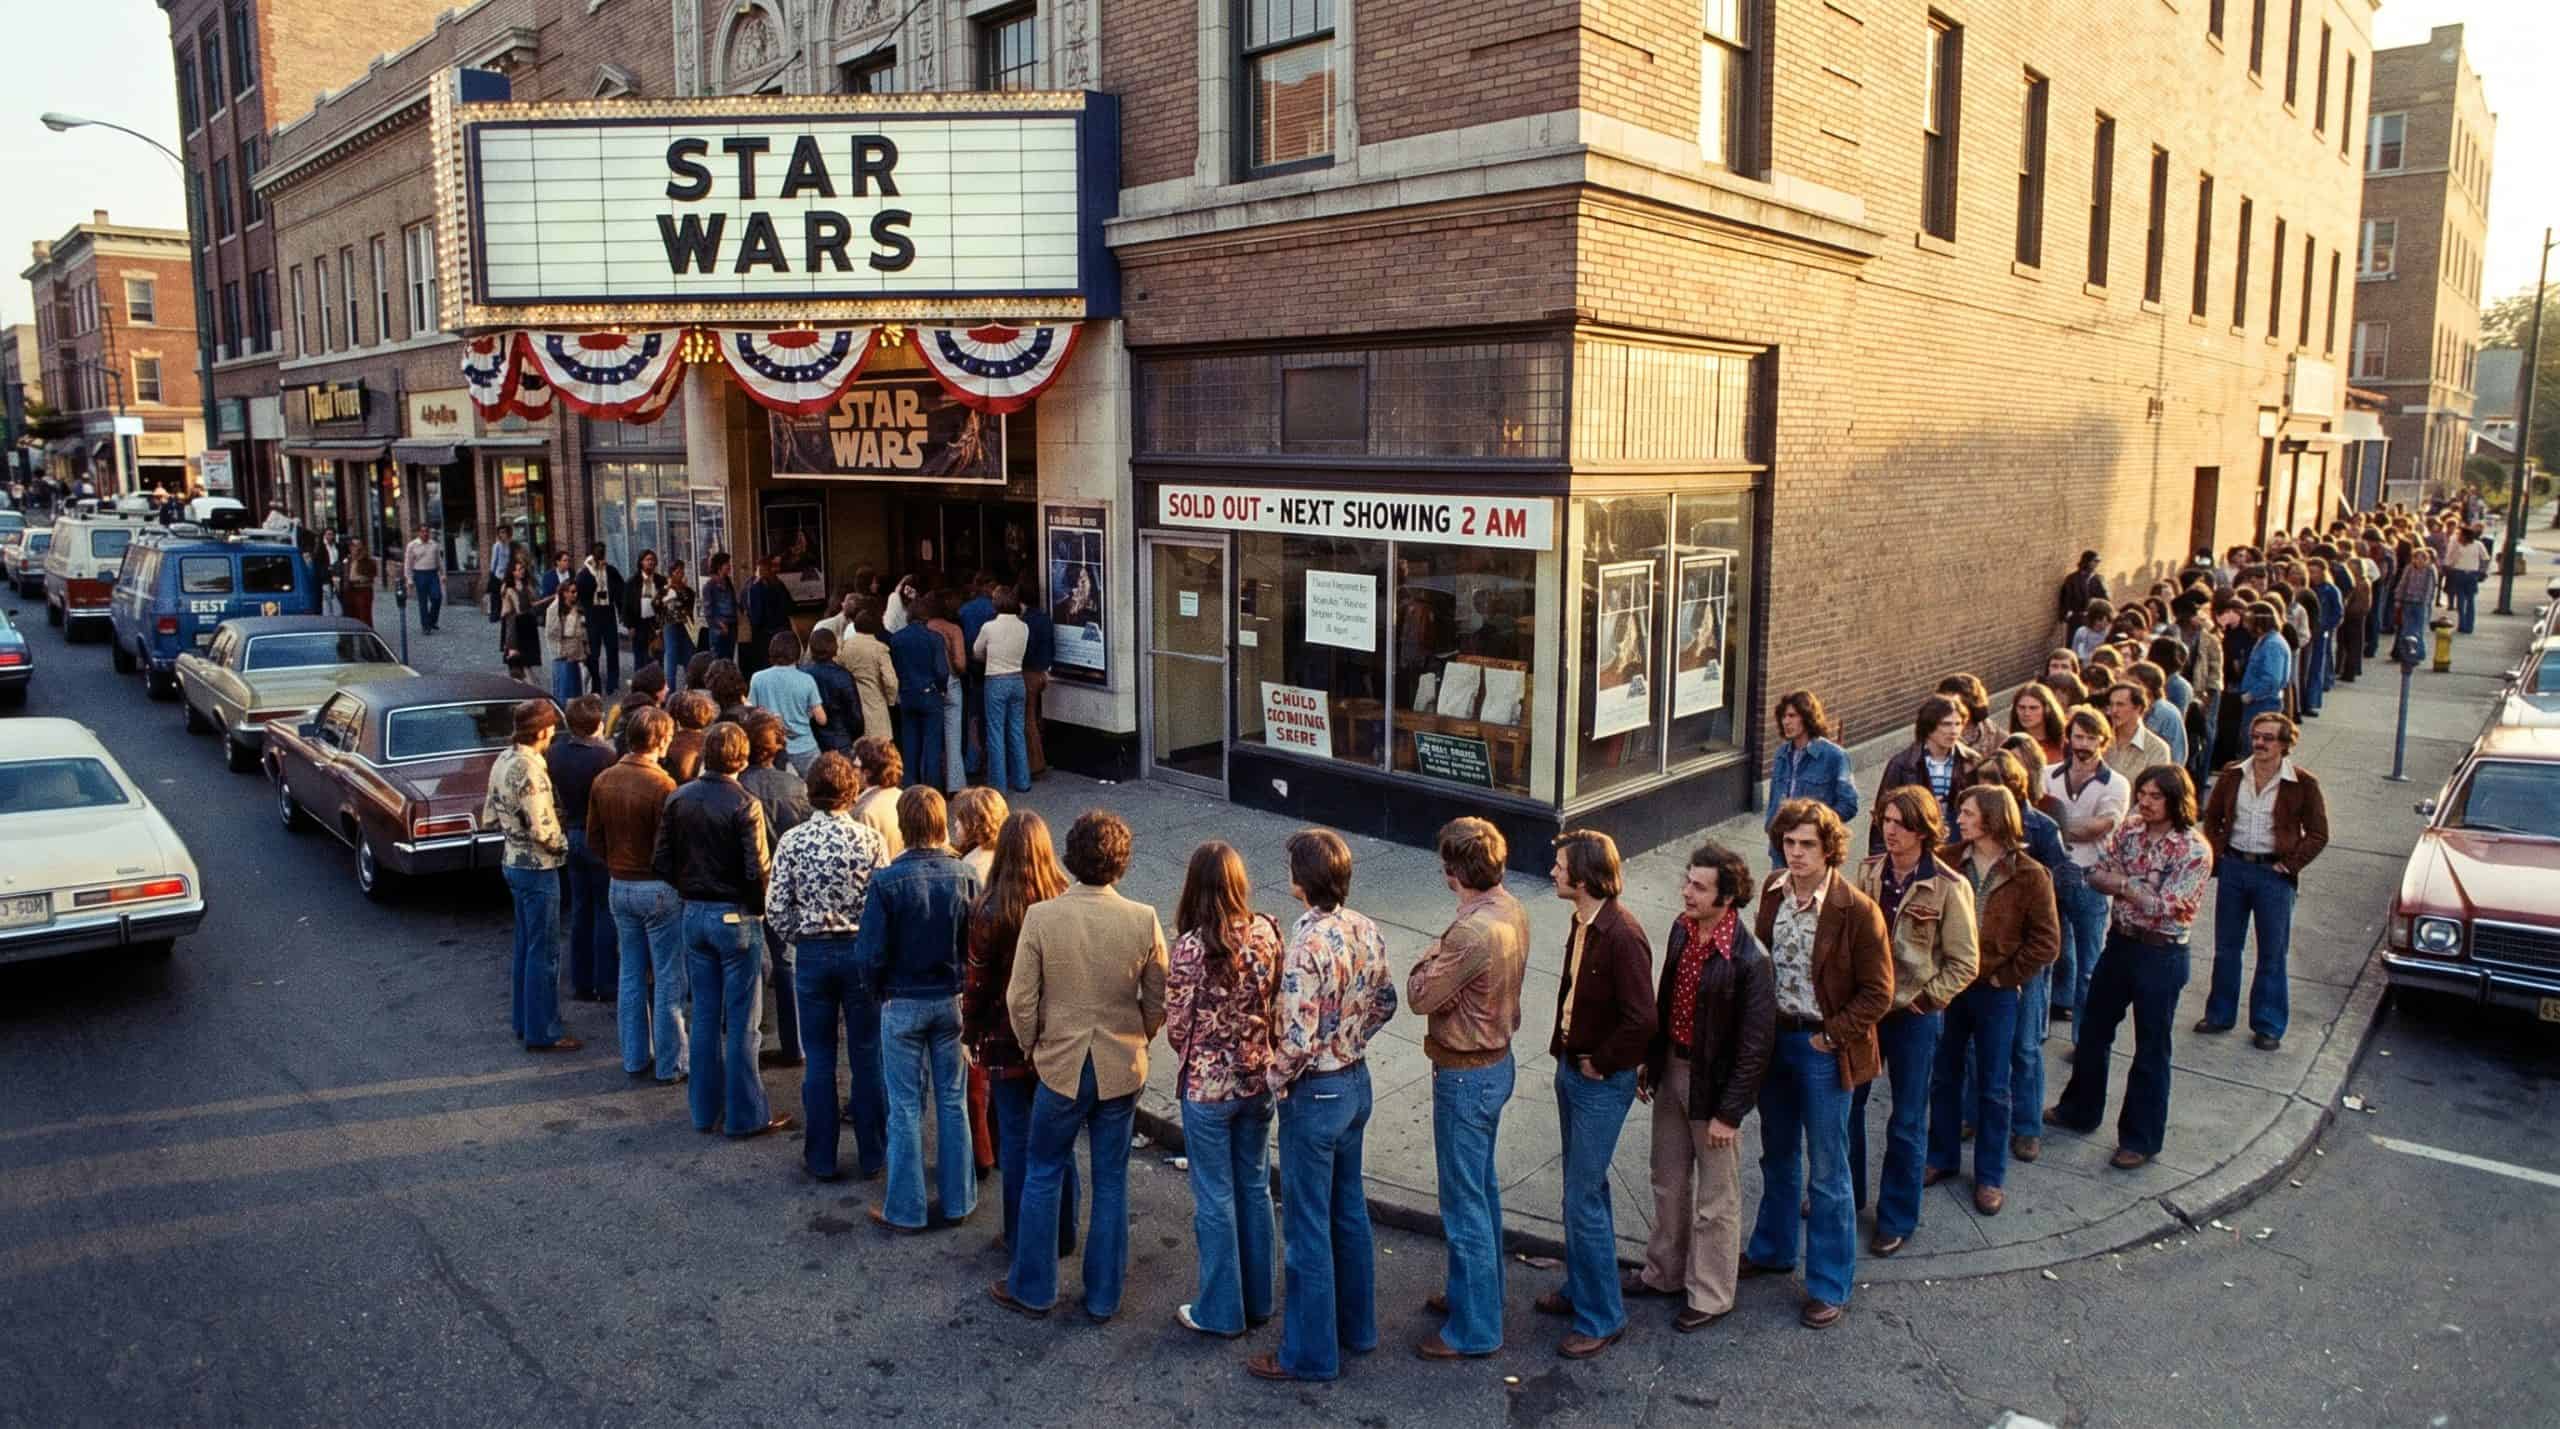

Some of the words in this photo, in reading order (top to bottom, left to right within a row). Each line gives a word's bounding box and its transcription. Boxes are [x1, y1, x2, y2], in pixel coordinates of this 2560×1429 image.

[665, 134, 900, 202] STAR
[656, 208, 916, 275] WARS
[829, 389, 928, 429] STAR
[829, 429, 929, 469] WARS
[1168, 492, 1215, 519] SOLD
[1222, 495, 1262, 522] OUT
[1280, 497, 1335, 526] NEXT
[1343, 500, 1450, 533] SHOWING
[1461, 505, 1476, 536] 2
[1486, 507, 1527, 538] AM
